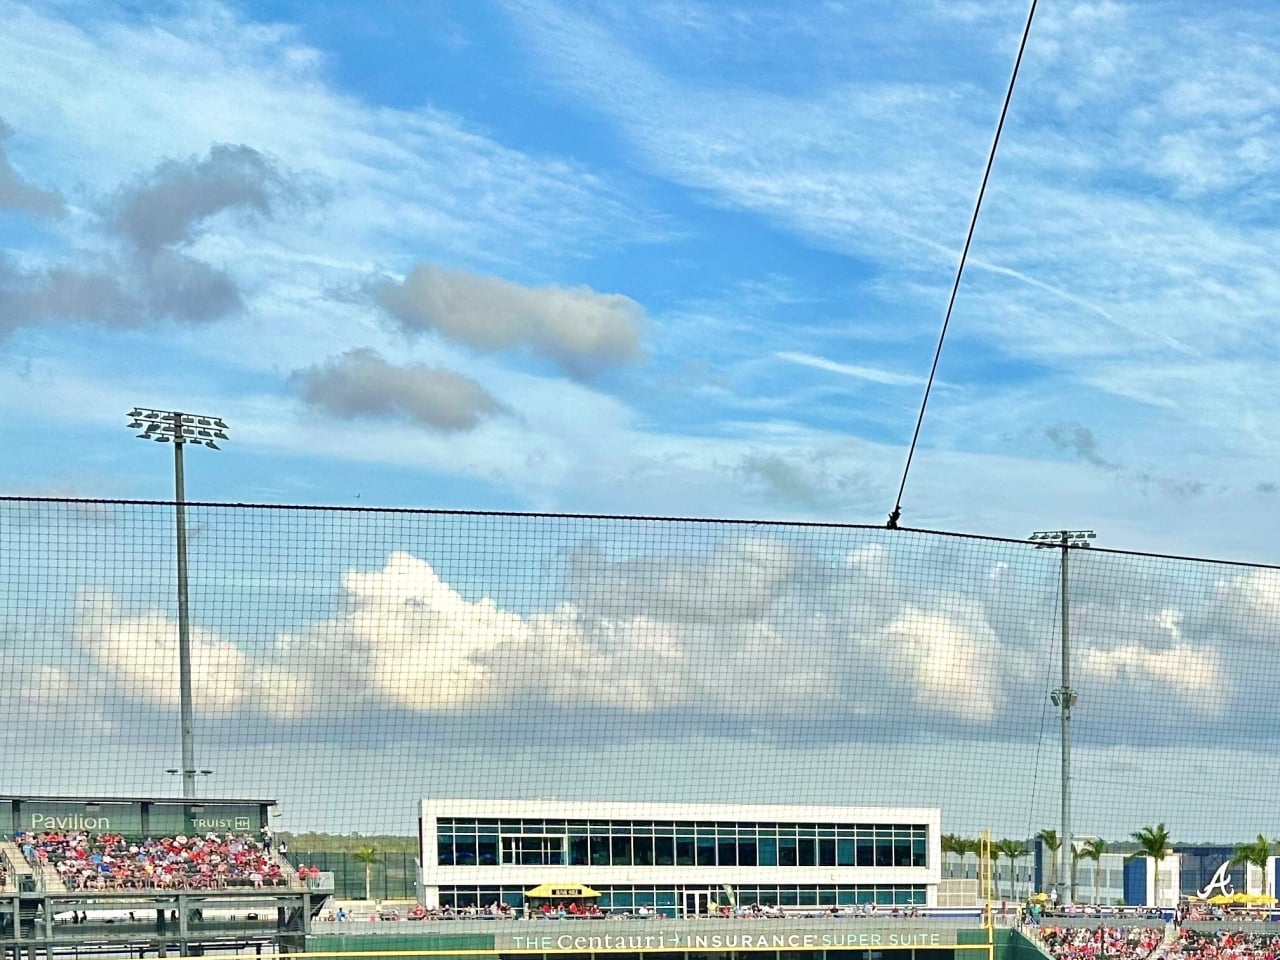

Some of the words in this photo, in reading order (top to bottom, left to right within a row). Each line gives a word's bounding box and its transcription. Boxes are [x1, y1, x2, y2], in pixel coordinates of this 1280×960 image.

[31, 813, 110, 830] Pavilion
[191, 818, 232, 828] TRUIST
[1197, 859, 1235, 900] A
[512, 936, 552, 949] THE
[557, 931, 665, 949] Centauri
[687, 934, 814, 948] INSURANCE
[822, 934, 882, 946] SUPER
[889, 933, 940, 946] SUITE
